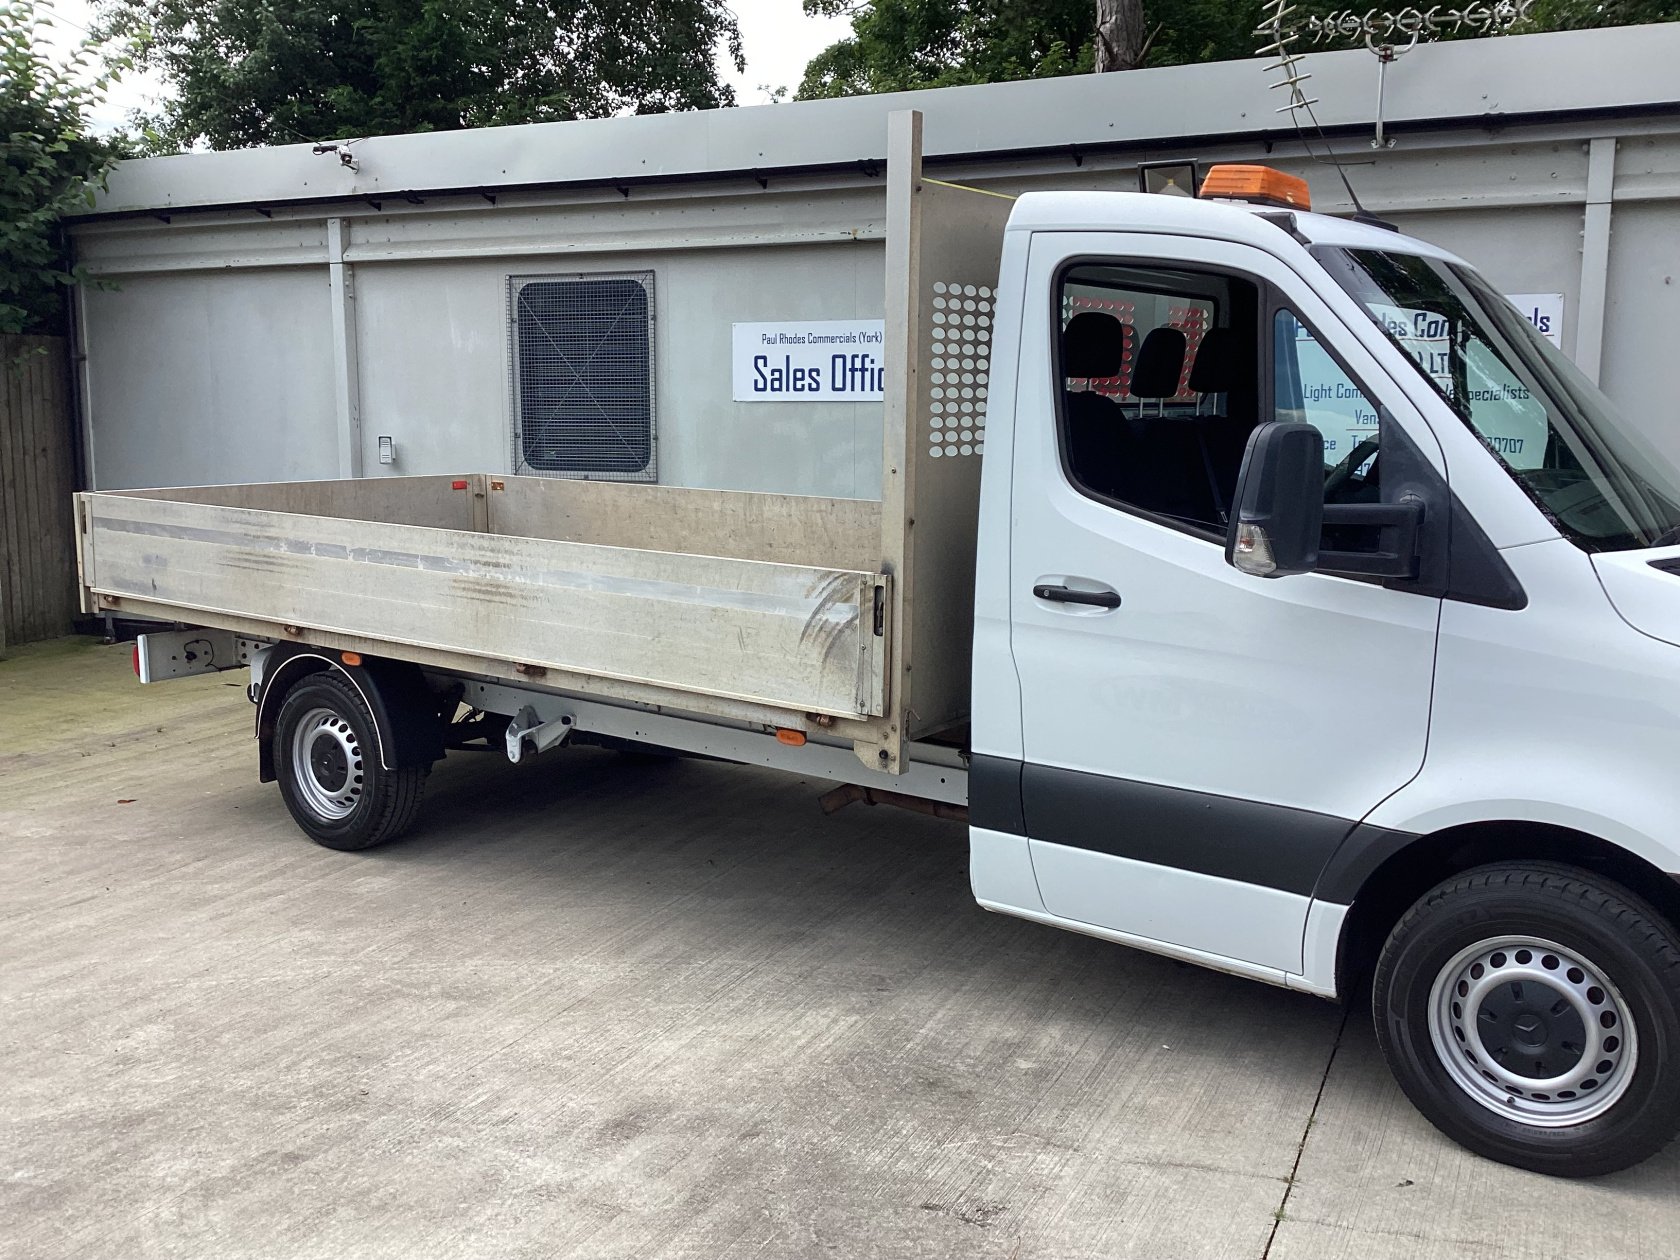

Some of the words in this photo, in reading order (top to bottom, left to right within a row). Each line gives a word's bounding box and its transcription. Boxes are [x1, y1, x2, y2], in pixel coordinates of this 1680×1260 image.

[761, 333, 778, 345] Paul
[779, 333, 806, 345] Rhodes
[807, 332, 857, 345] Commercials
[858, 332, 883, 345] (York)
[753, 355, 821, 392] Sales
[831, 354, 885, 392] Offic
[1304, 383, 1333, 402] Light
[1469, 383, 1530, 402] pecialists
[1355, 409, 1380, 425] Van
